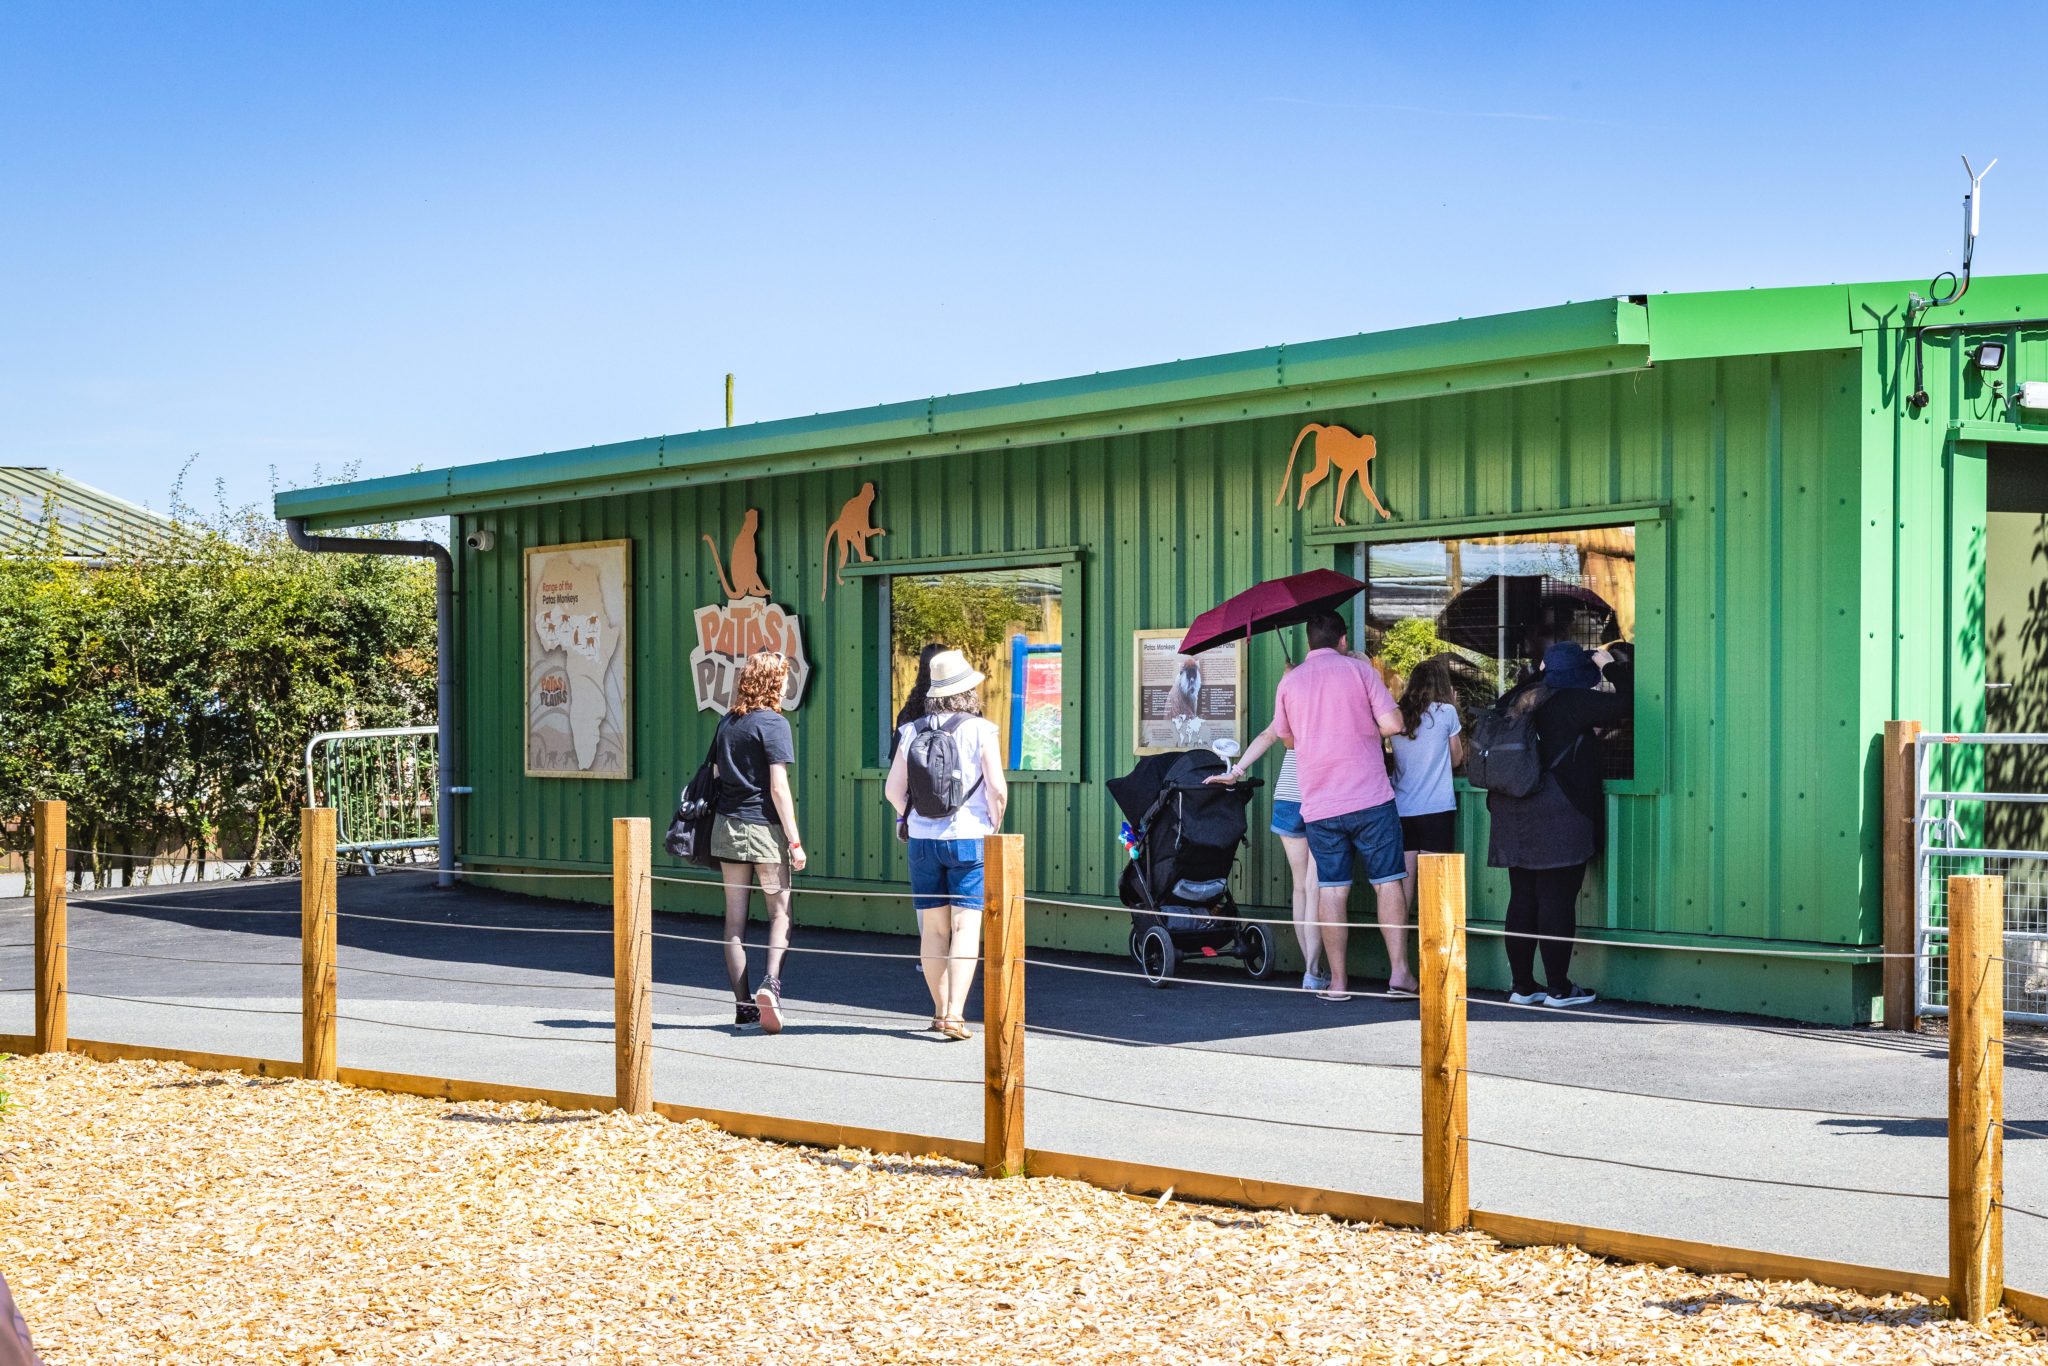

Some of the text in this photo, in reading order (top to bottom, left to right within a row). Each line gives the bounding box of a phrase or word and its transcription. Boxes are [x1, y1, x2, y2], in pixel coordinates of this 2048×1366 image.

[542, 580, 573, 594] Range of the
[542, 593, 579, 605] Patas Monkeys
[701, 607, 784, 658] PATAS
[541, 676, 563, 690] PATAS
[697, 657, 800, 709] PLS
[540, 690, 568, 707] PLAINS
